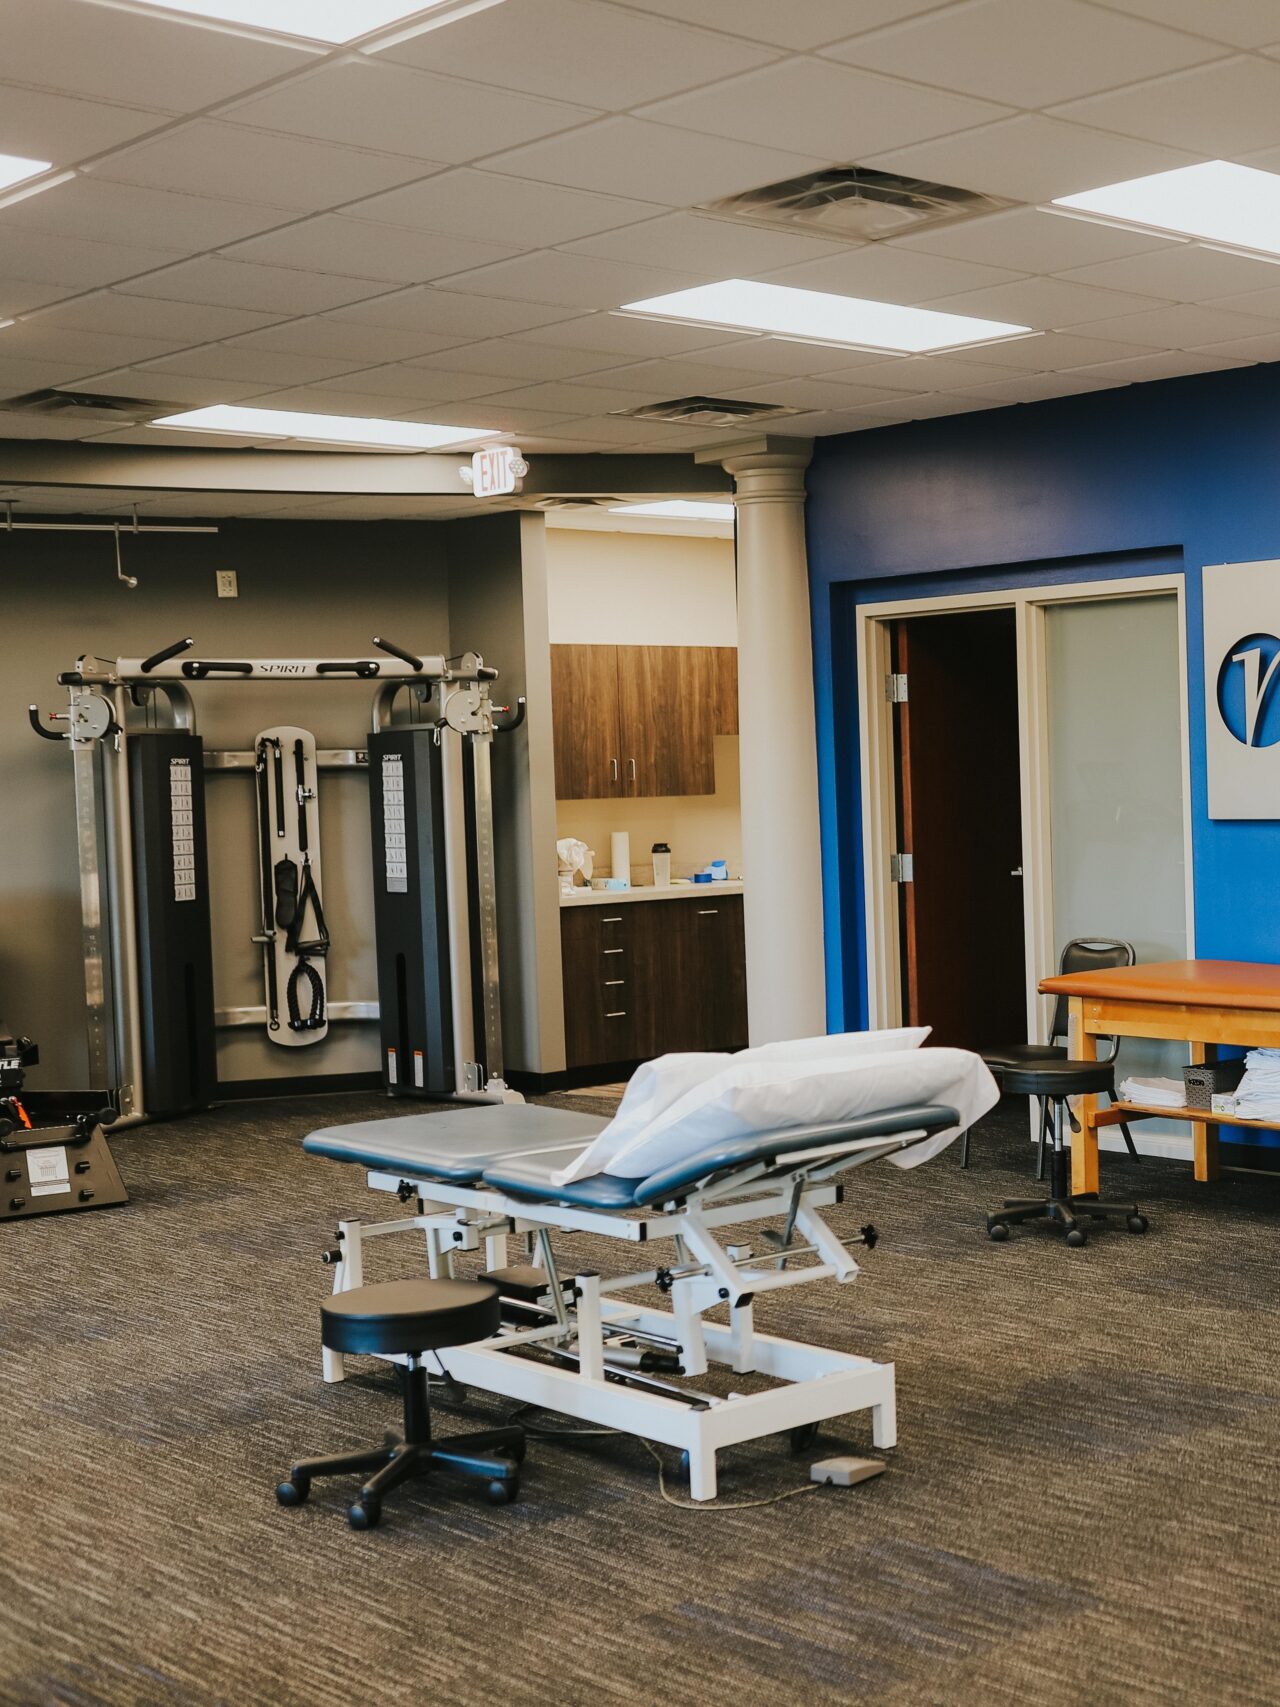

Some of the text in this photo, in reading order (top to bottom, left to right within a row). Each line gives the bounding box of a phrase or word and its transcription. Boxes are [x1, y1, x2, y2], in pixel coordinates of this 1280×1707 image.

[479, 450, 509, 492] EXIT
[259, 664, 309, 674] SPIRIT
[170, 757, 190, 765] SPIRIT
[382, 753, 402, 761] SPIRIT
